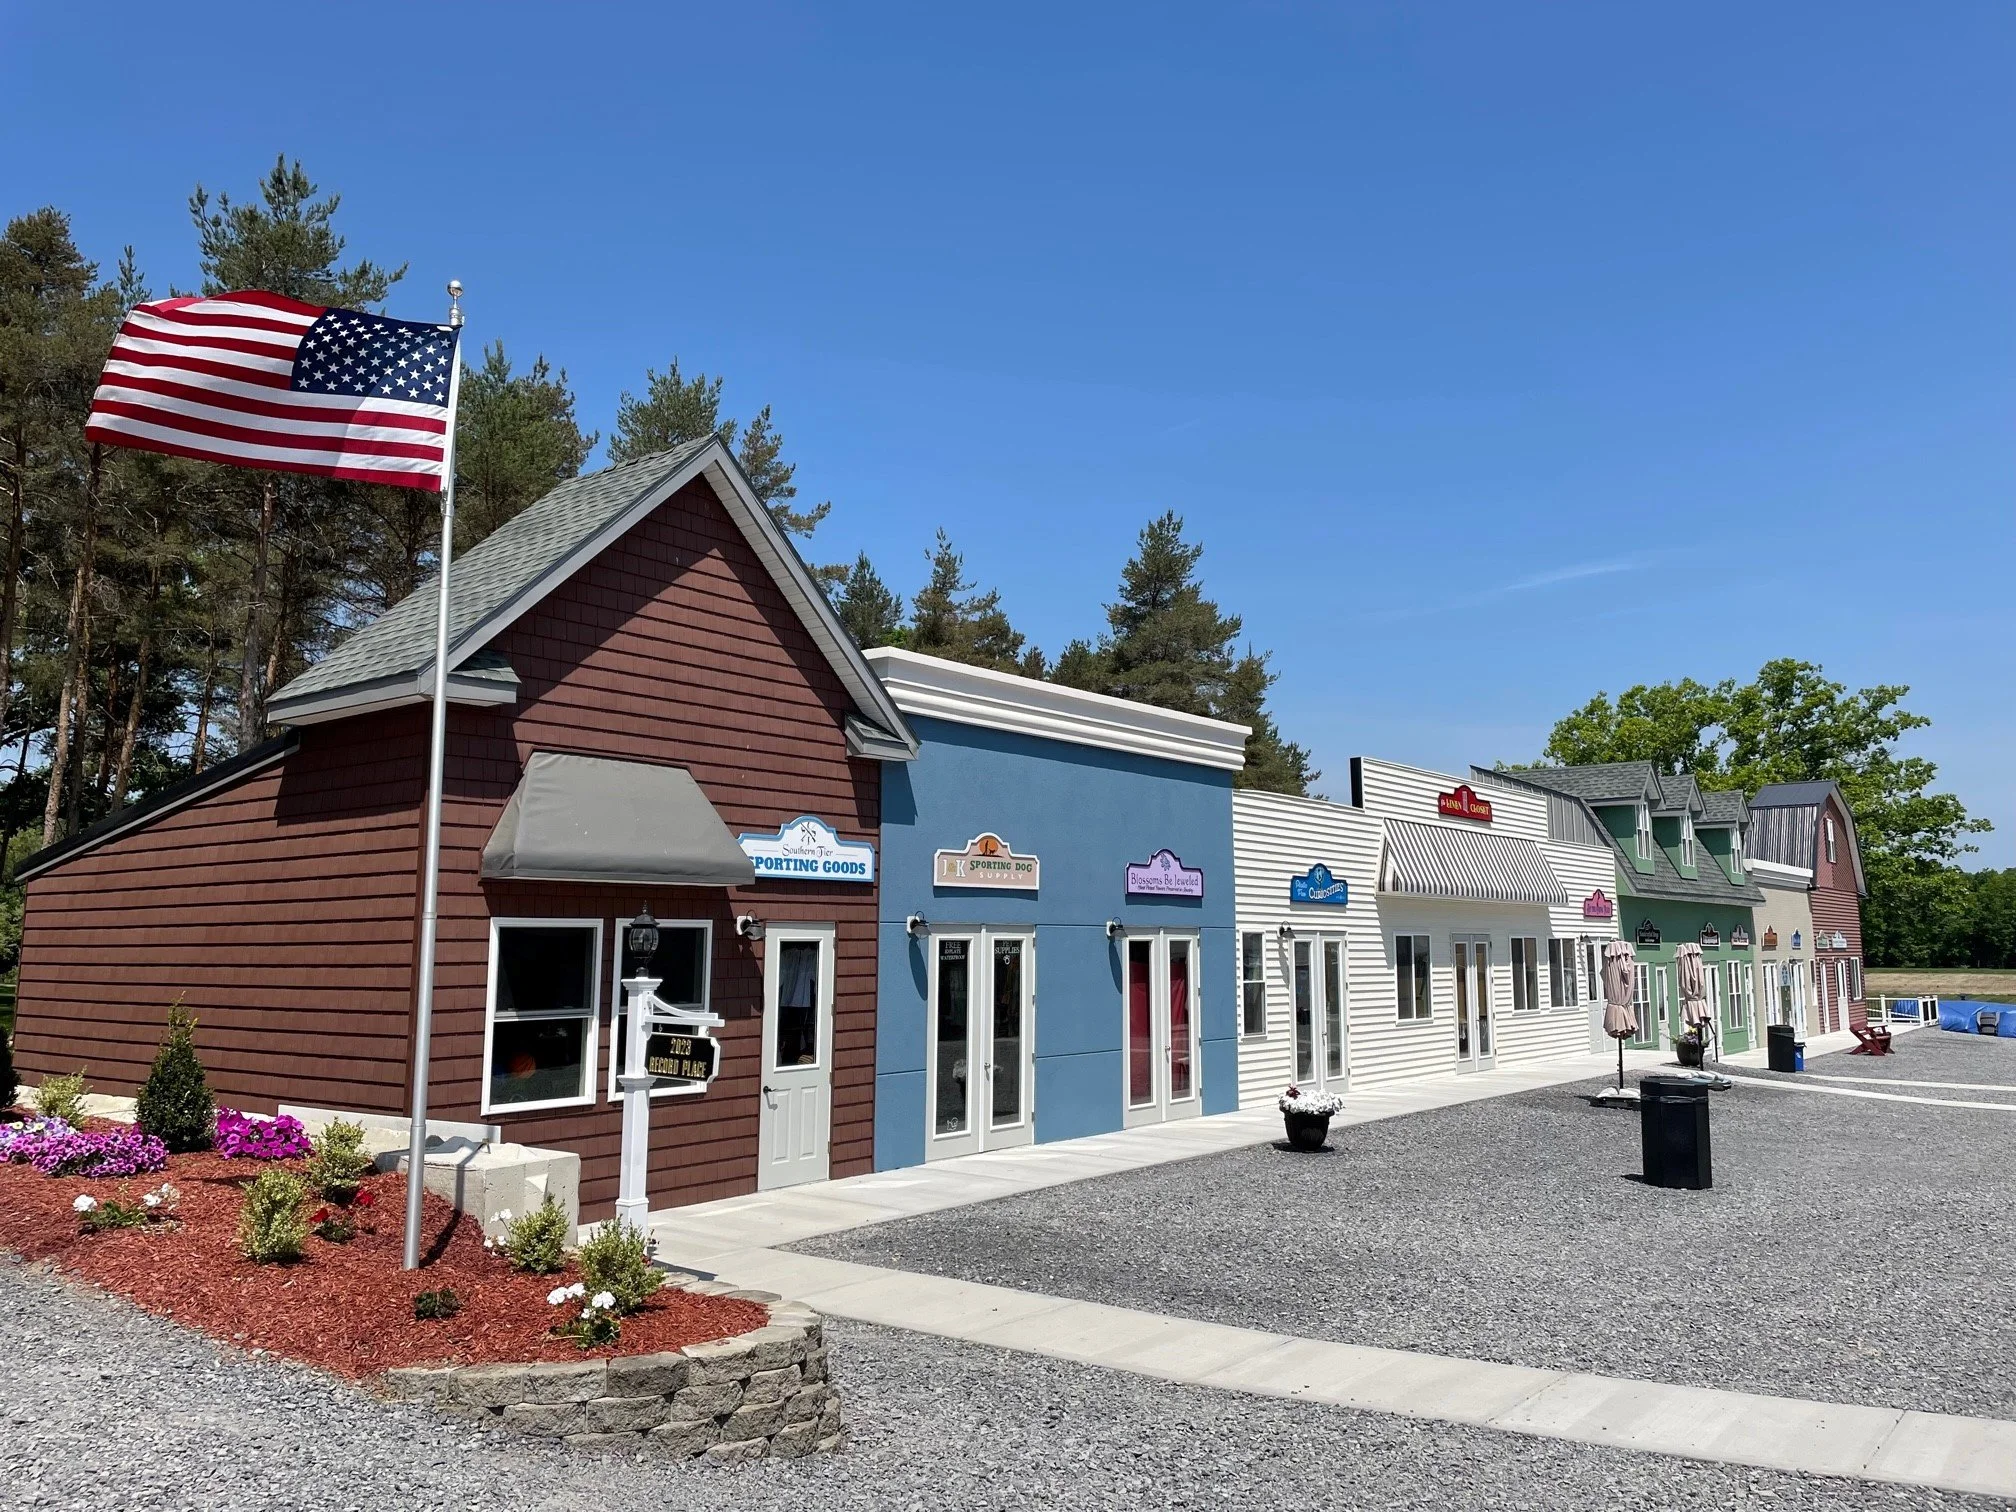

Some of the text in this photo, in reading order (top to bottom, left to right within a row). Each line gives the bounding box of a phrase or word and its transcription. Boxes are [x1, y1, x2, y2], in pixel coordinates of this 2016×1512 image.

[1470, 803, 1489, 815] CLOSET
[781, 843, 833, 858] Southern Tier
[822, 861, 866, 875] GOODS
[969, 860, 1012, 871] SPORTING
[1015, 862, 1033, 872] DOG
[979, 871, 1024, 880] SUPPLY
[1130, 872, 1199, 887] Blossoms Be Jeweled
[944, 941, 962, 949] FREE
[994, 946, 1020, 954] SUPPLIES
[670, 1038, 692, 1055] 2023
[649, 1056, 707, 1078] RECORD PLACE
